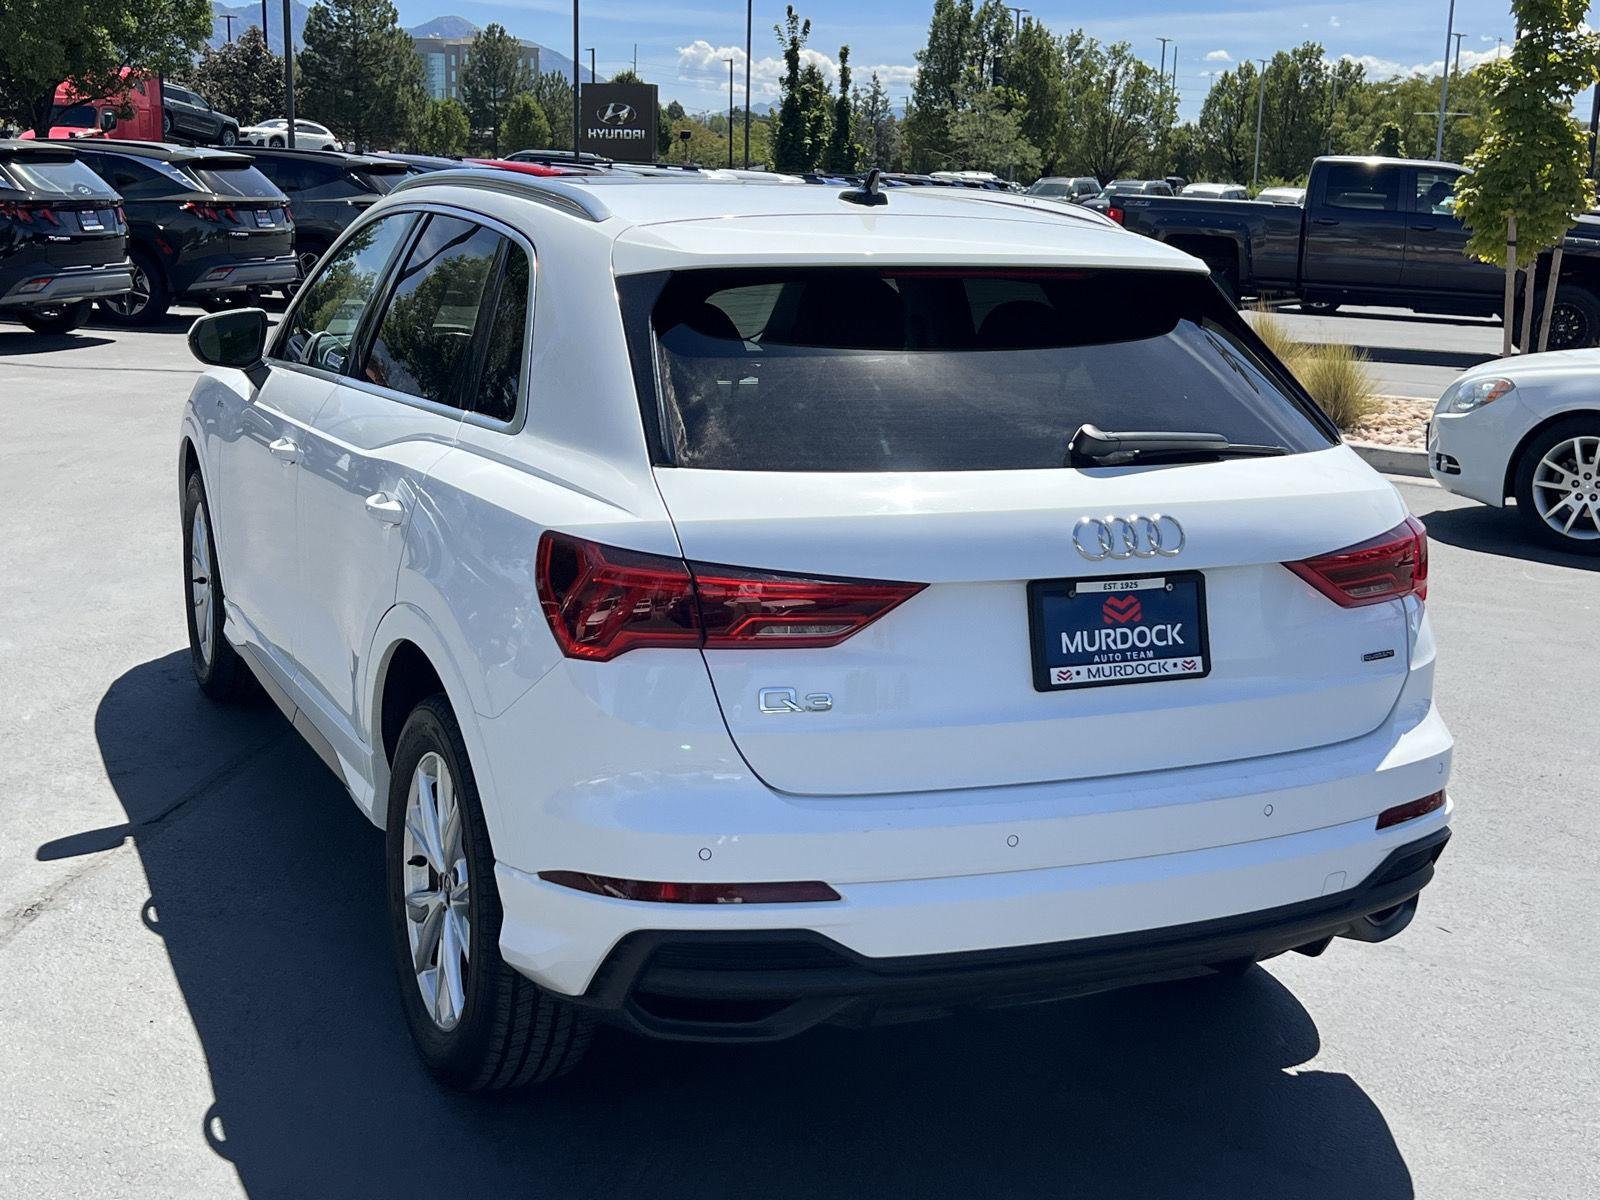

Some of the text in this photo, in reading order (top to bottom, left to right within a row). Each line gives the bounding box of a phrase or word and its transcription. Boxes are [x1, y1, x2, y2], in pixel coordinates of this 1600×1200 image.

[588, 128, 646, 140] HYUNDAI
[1103, 581, 1138, 591] EST. 1925
[1061, 623, 1184, 654] MURDOCK
[1093, 650, 1154, 663] AUTO TEAM
[1087, 661, 1169, 680] MURDOCK
[759, 687, 832, 713] Q3
